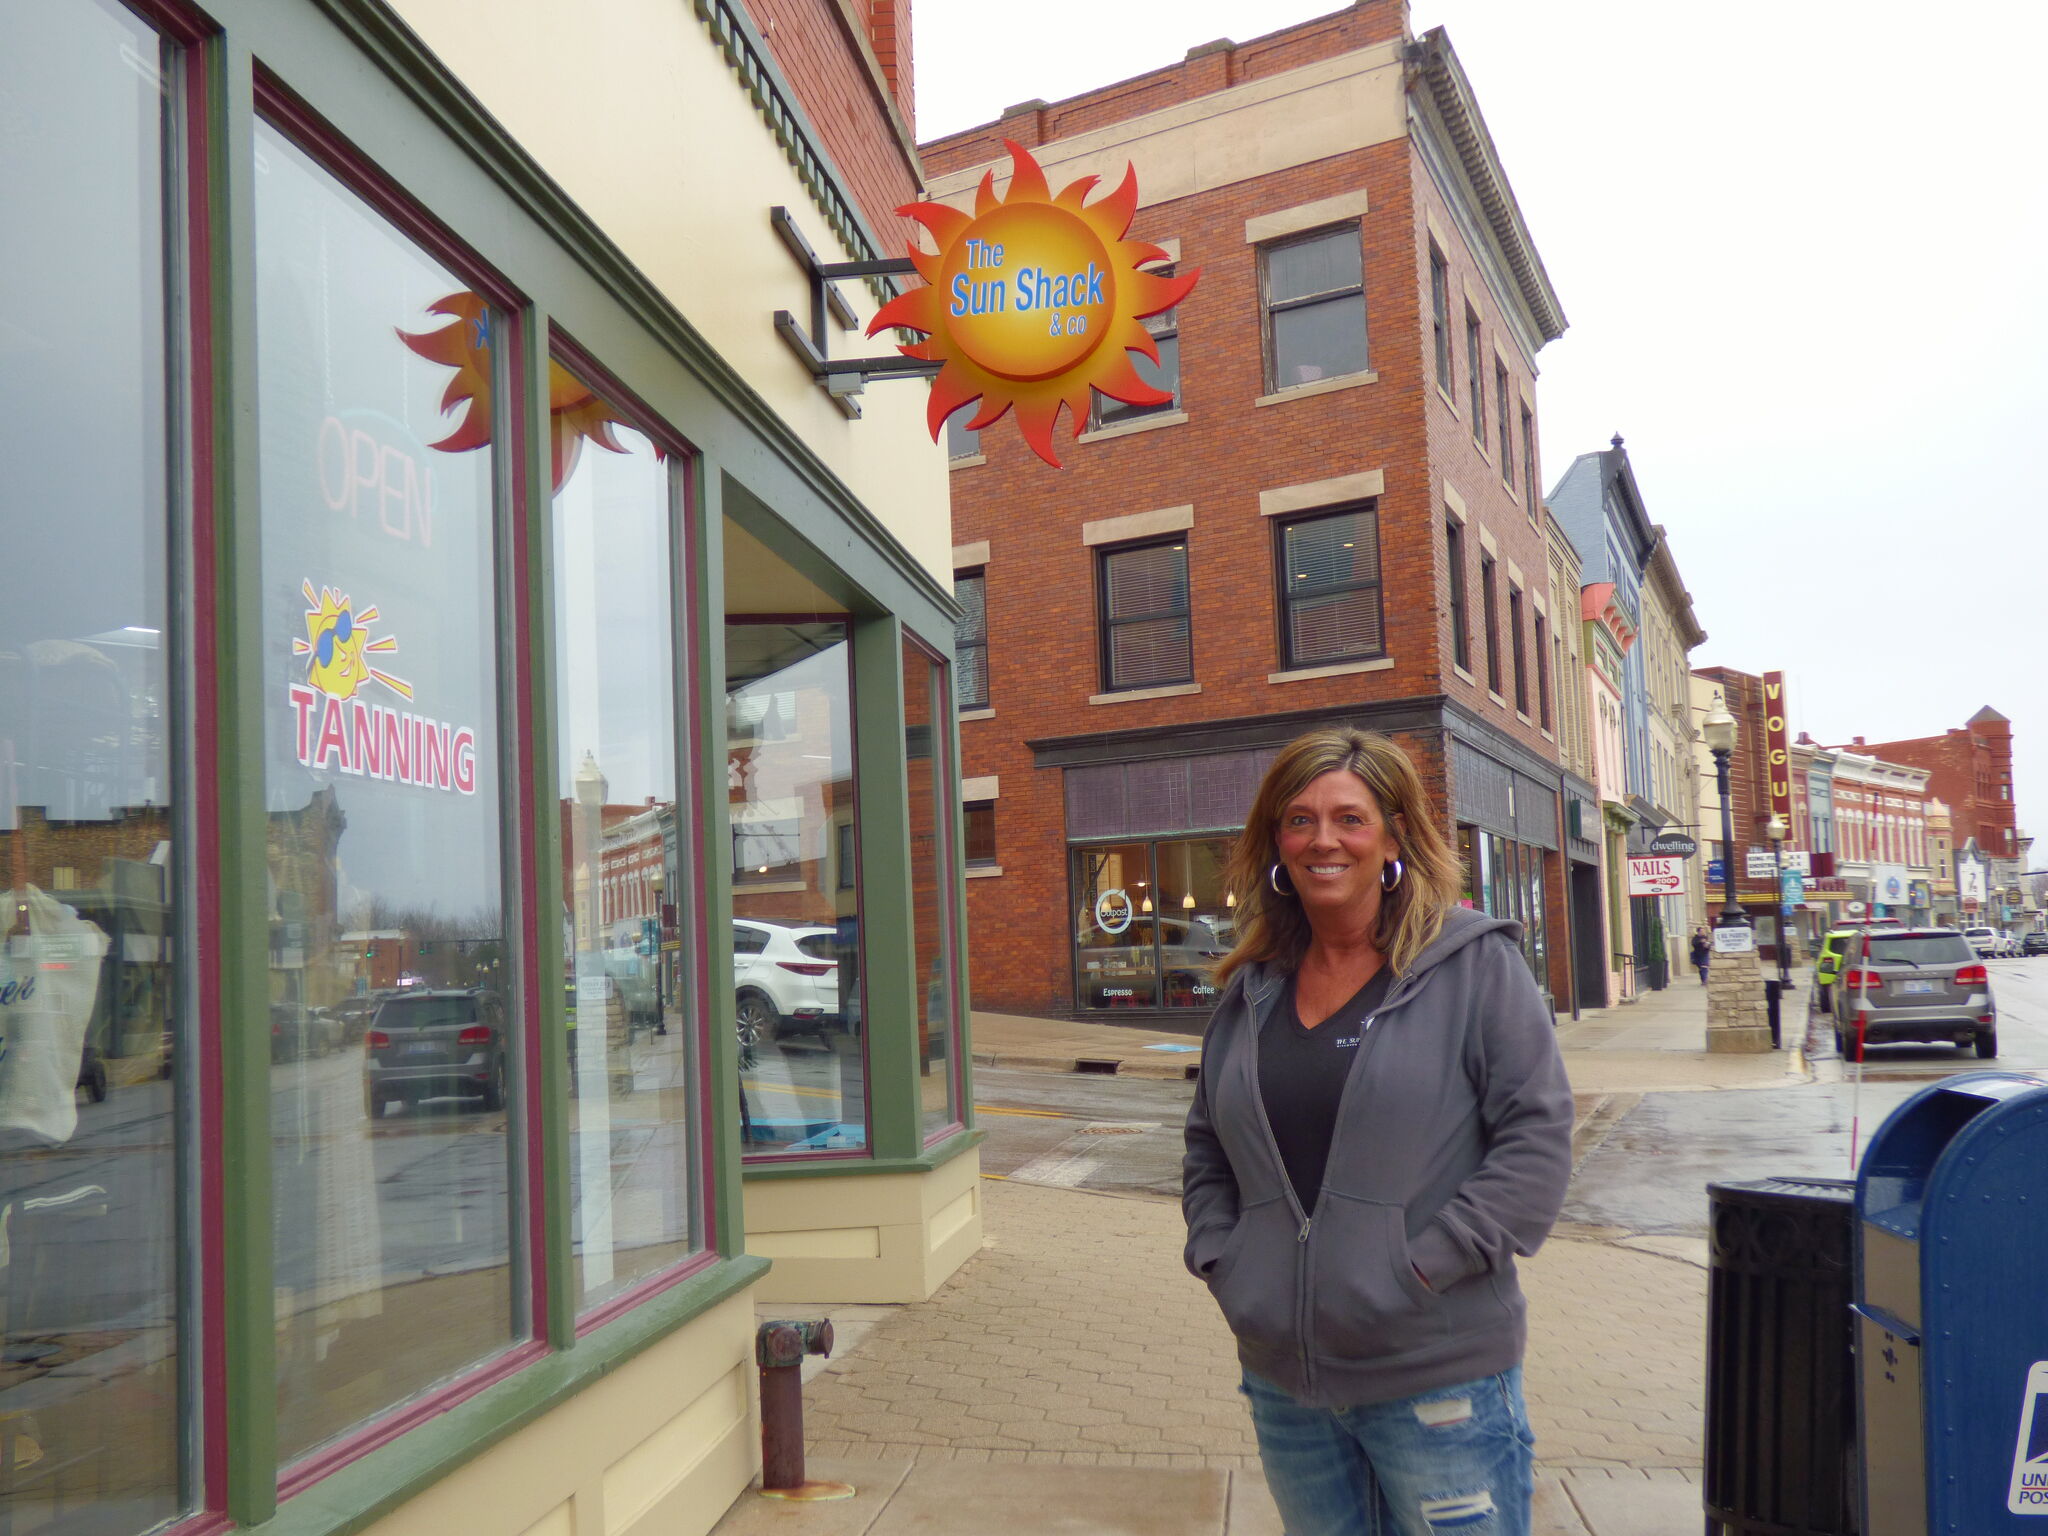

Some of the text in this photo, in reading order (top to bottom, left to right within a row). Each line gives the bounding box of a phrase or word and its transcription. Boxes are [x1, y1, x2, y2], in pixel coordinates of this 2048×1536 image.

[965, 239, 1004, 269] The
[950, 261, 1104, 317] Sun Shack
[1049, 312, 1087, 336] & co
[316, 415, 433, 549] OPEN
[289, 682, 477, 797] TANNING
[1766, 683, 1790, 830] VOGUE
[1651, 840, 1695, 851] dwelling
[1632, 860, 1671, 876] NAILS
[1101, 907, 1128, 918] Outpost
[1103, 988, 1133, 998] Espresso
[1193, 985, 1215, 994] Coffee
[2022, 1473, 2048, 1486] UN
